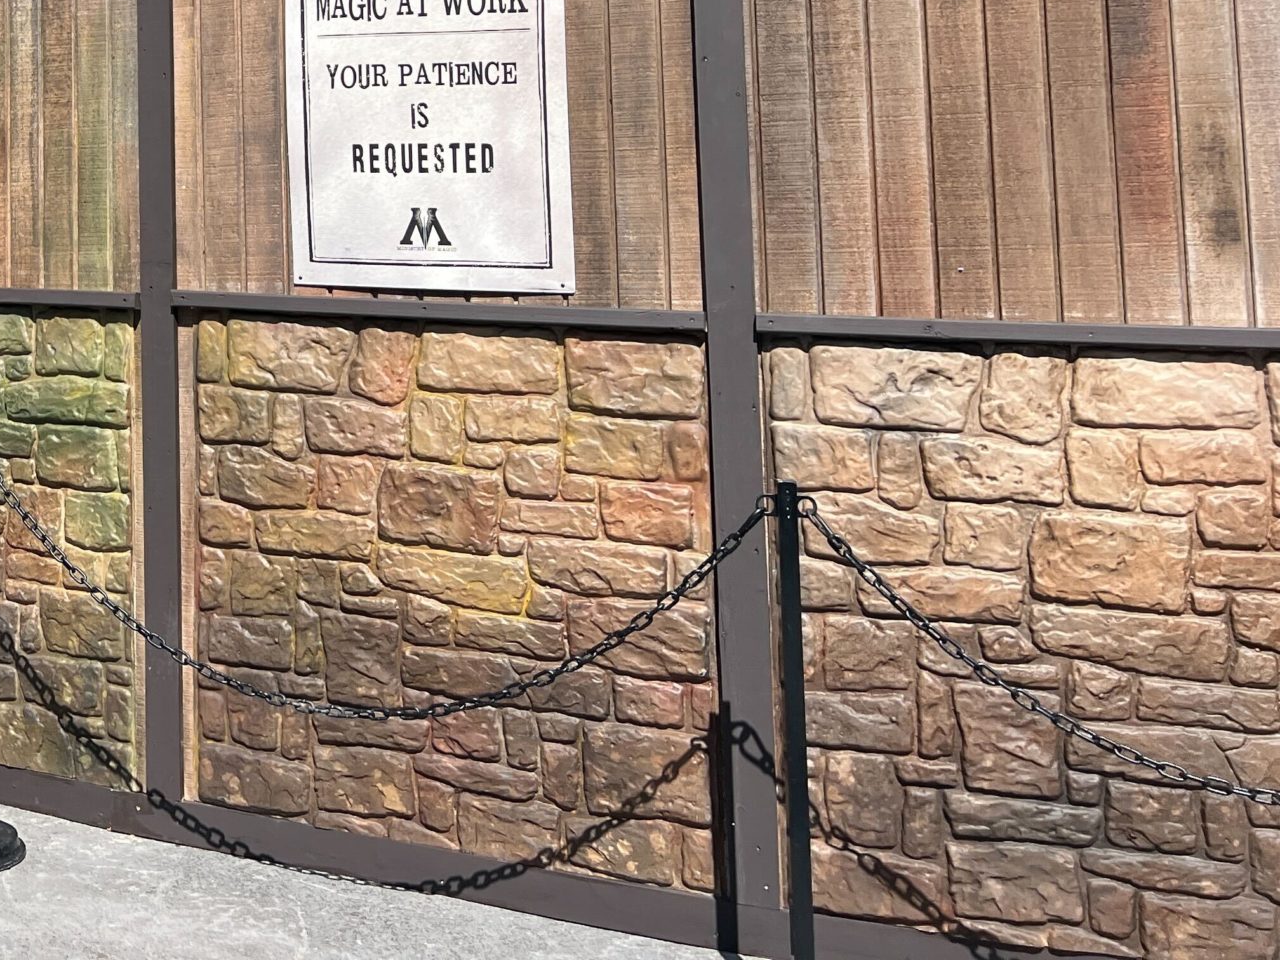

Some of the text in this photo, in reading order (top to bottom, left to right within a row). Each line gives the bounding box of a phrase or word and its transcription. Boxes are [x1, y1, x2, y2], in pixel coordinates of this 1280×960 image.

[327, 62, 517, 89] YOUR PATIENCE
[411, 103, 429, 129] IS
[353, 143, 494, 177] REQUESTED
